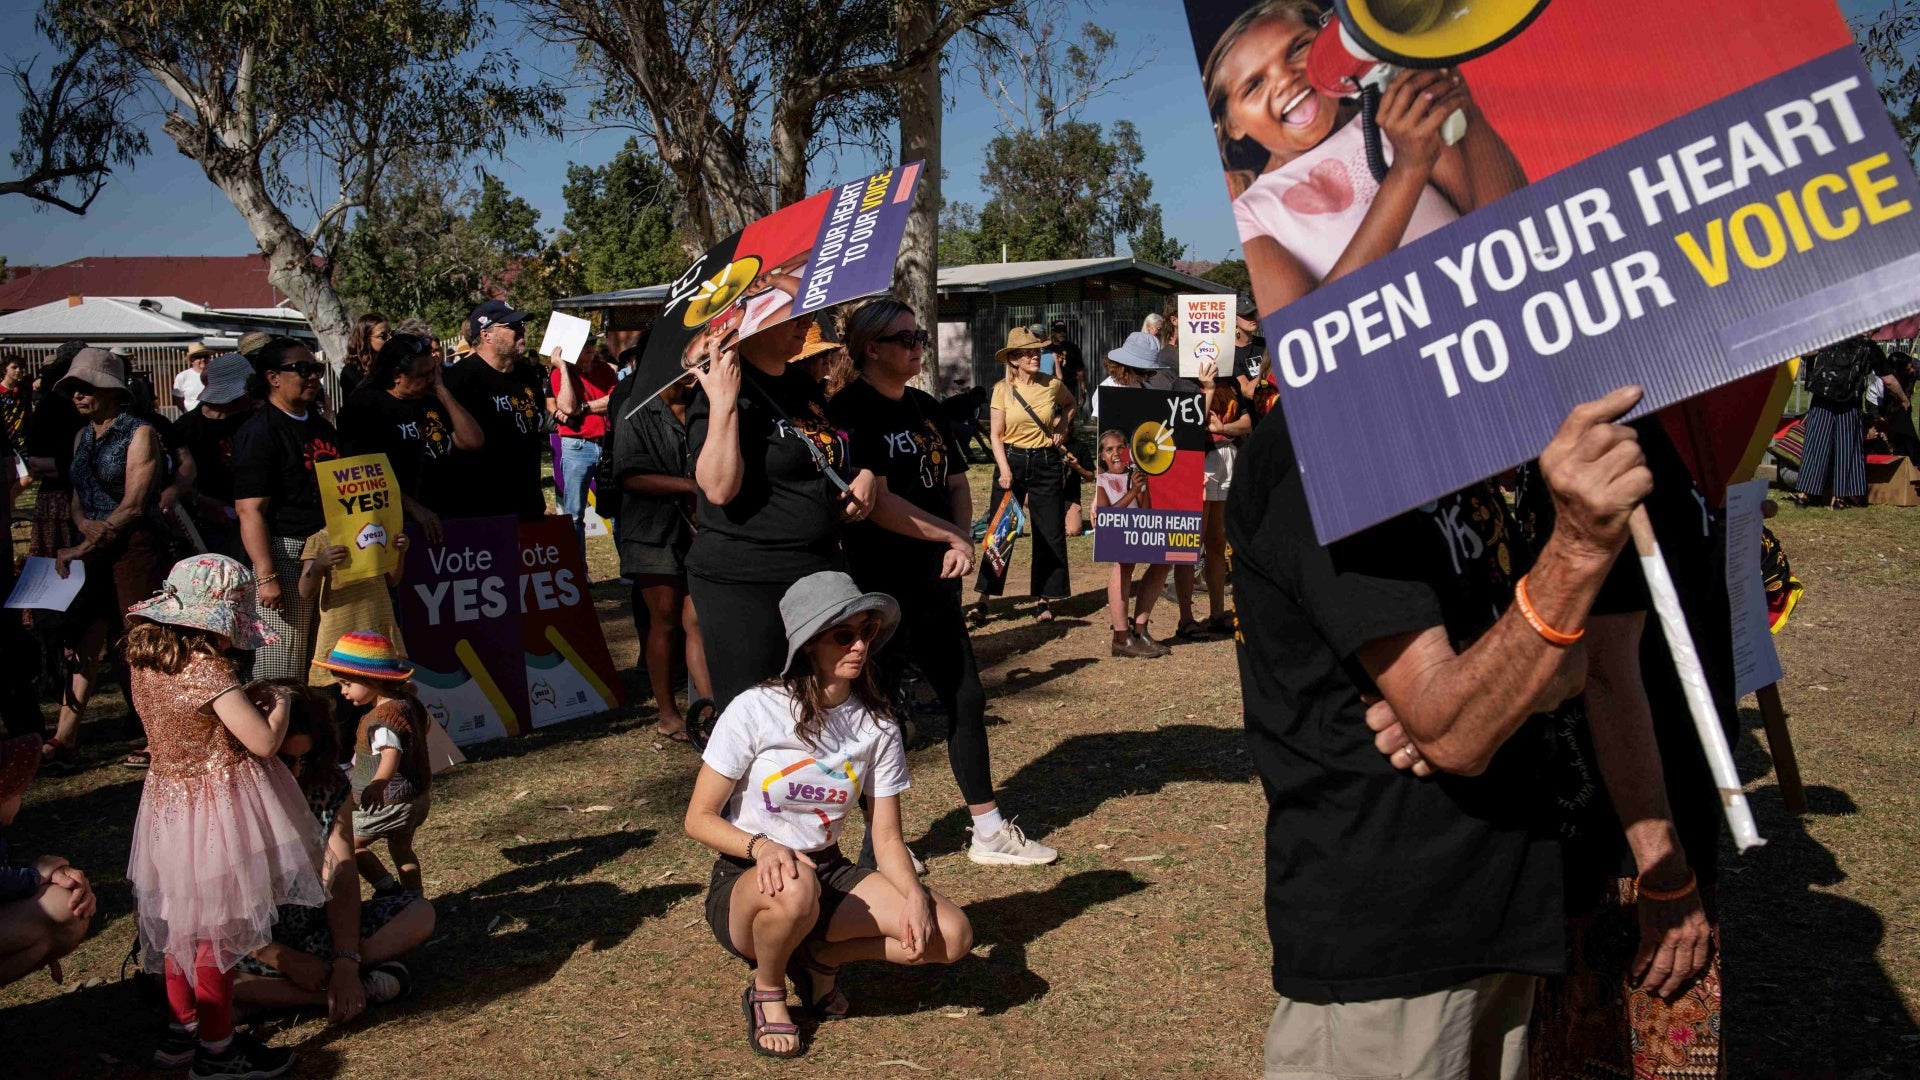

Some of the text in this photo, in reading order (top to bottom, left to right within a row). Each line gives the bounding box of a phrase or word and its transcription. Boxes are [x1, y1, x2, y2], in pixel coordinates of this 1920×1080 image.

[841, 170, 893, 267] TO OUR VOICE
[1278, 75, 1865, 388] OPEN YOUR HEART
[802, 181, 865, 309] OPEN YOUR HEART
[663, 254, 708, 318] YES
[1419, 318, 1509, 399] TO
[1521, 250, 1676, 356] OUR
[1674, 152, 1912, 288] VOICE
[1188, 301, 1226, 311] WE'RE
[1188, 312, 1226, 320] VOTING
[1188, 321, 1226, 334] YES!
[492, 395, 513, 412] YES
[1166, 394, 1204, 428] YES
[397, 421, 420, 440] YES
[883, 430, 918, 458] YES
[332, 463, 384, 483] WE'RE
[336, 477, 388, 496] VOTING
[338, 490, 390, 515] YES!
[1097, 512, 1202, 531] OPEN YOUR HEART
[1124, 531, 1201, 548] TO OUR VOICE
[428, 546, 492, 575] Vote
[520, 542, 560, 567] ote
[413, 575, 508, 626] YES
